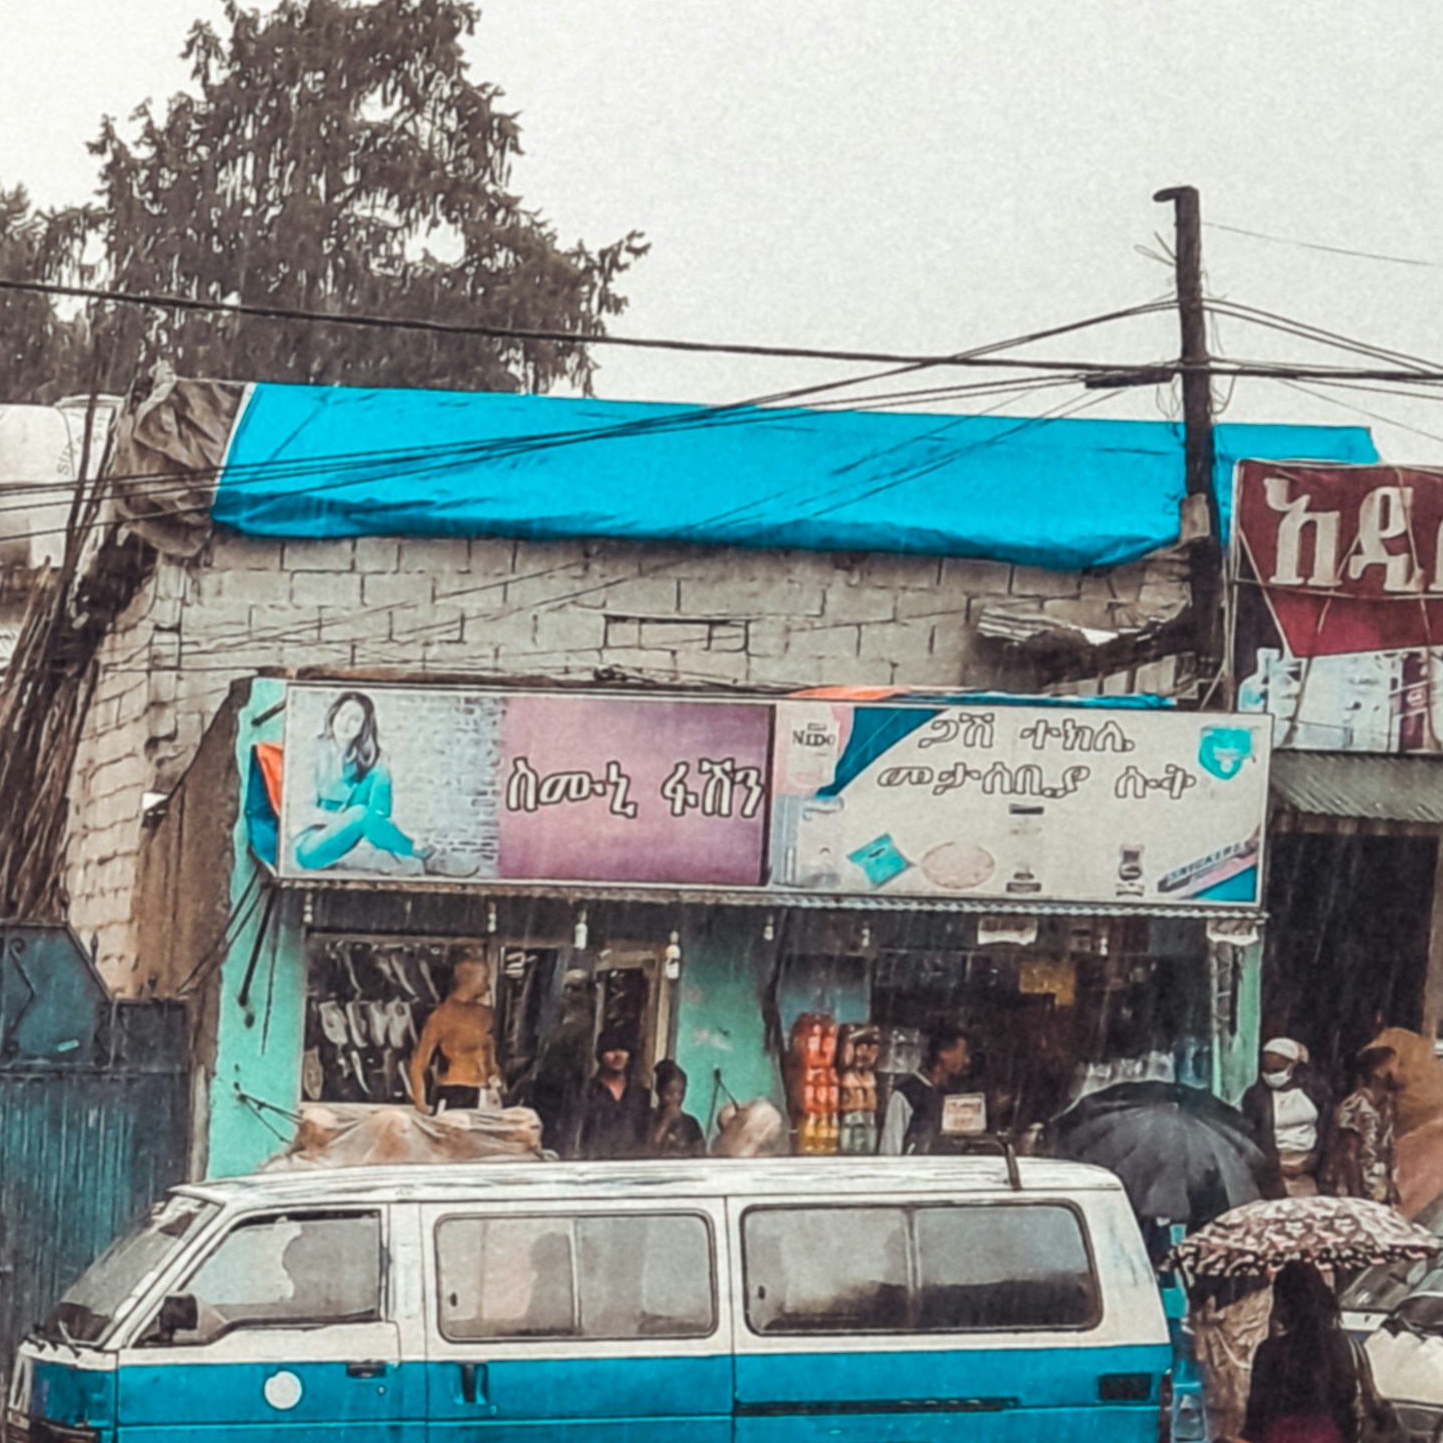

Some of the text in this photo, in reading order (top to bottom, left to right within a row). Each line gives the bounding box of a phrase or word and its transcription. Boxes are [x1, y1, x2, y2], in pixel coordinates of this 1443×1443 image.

[1263, 477, 1443, 592] አዲ
[791, 730, 836, 747] NIDO
[506, 756, 765, 819] ስሙኒ ፋሽን
